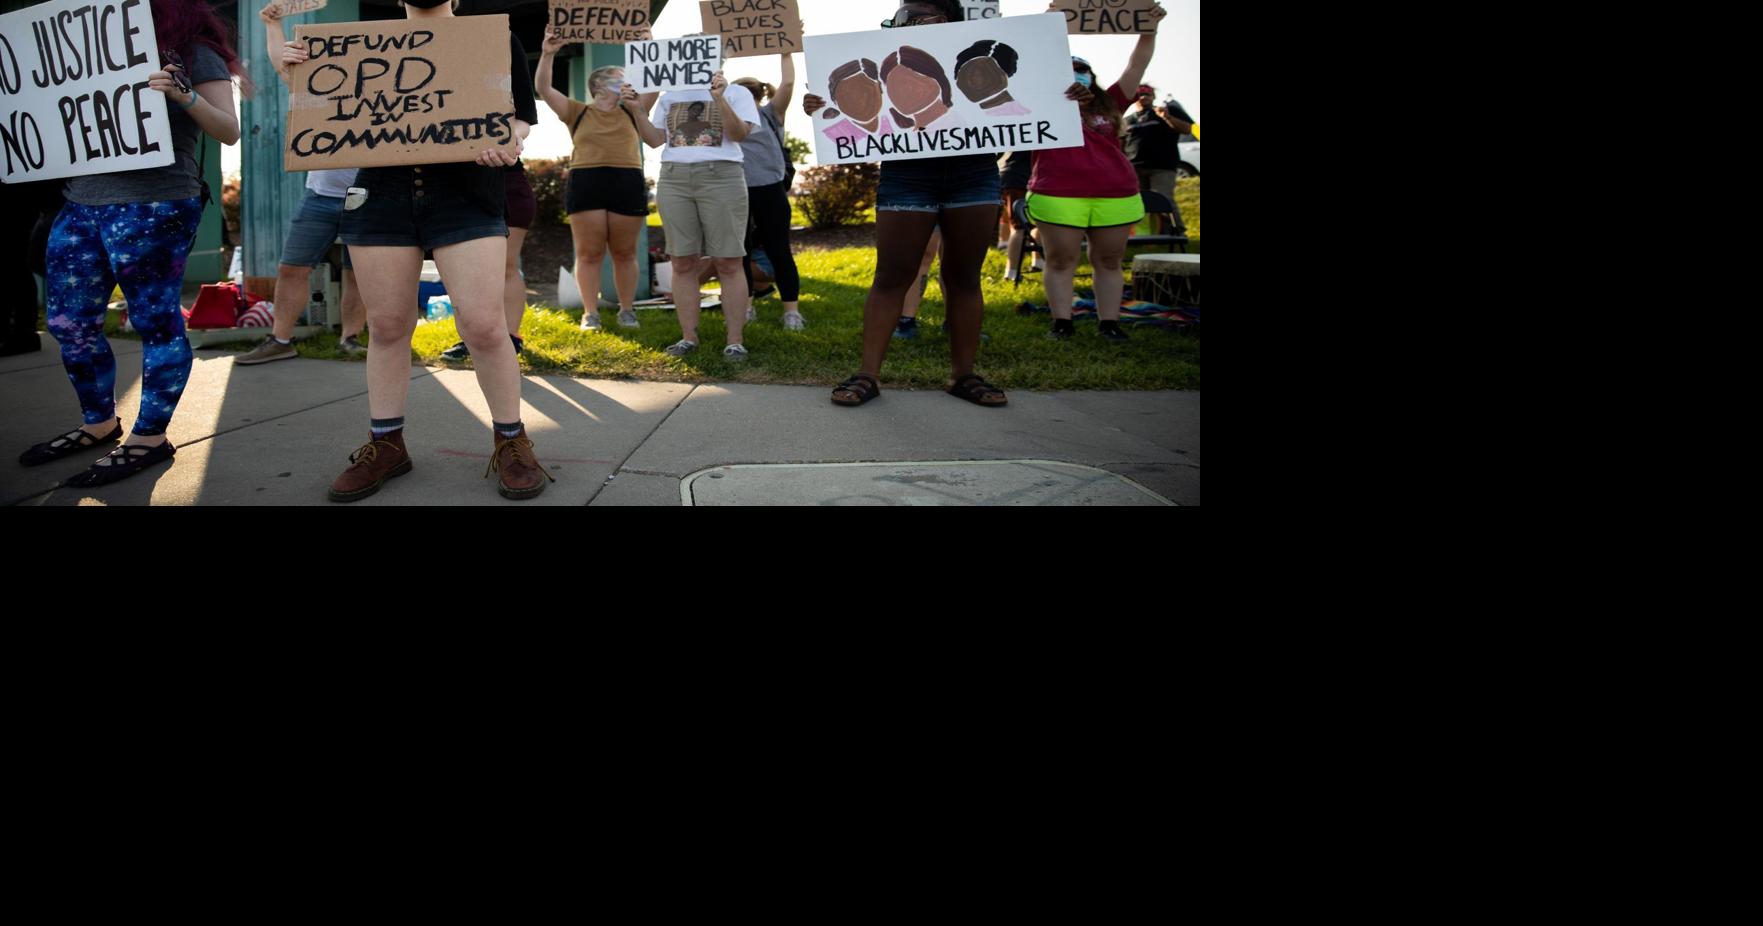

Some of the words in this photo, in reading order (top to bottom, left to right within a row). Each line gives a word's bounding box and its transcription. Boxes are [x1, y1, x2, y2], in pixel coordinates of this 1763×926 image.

[554, 7, 646, 26] DEFEND
[711, 0, 786, 17] BLACK
[1060, 9, 1154, 33] PEACE
[553, 28, 595, 39] BLACK
[602, 29, 642, 40] LIVES
[719, 14, 784, 33] LIVES
[0, 33, 21, 95] O
[32, 0, 148, 88] JUSTICE
[303, 31, 433, 59] DEFUND
[630, 42, 659, 64] NO
[668, 38, 718, 61] MORE
[726, 32, 794, 53] ATTER
[308, 57, 436, 98] OPD
[643, 62, 713, 88] NAMES
[328, 90, 453, 121] INVEST
[371, 111, 403, 125] IN
[0, 110, 45, 176] NO
[58, 80, 160, 164] PEACE
[291, 112, 514, 157] COMMUNITIES
